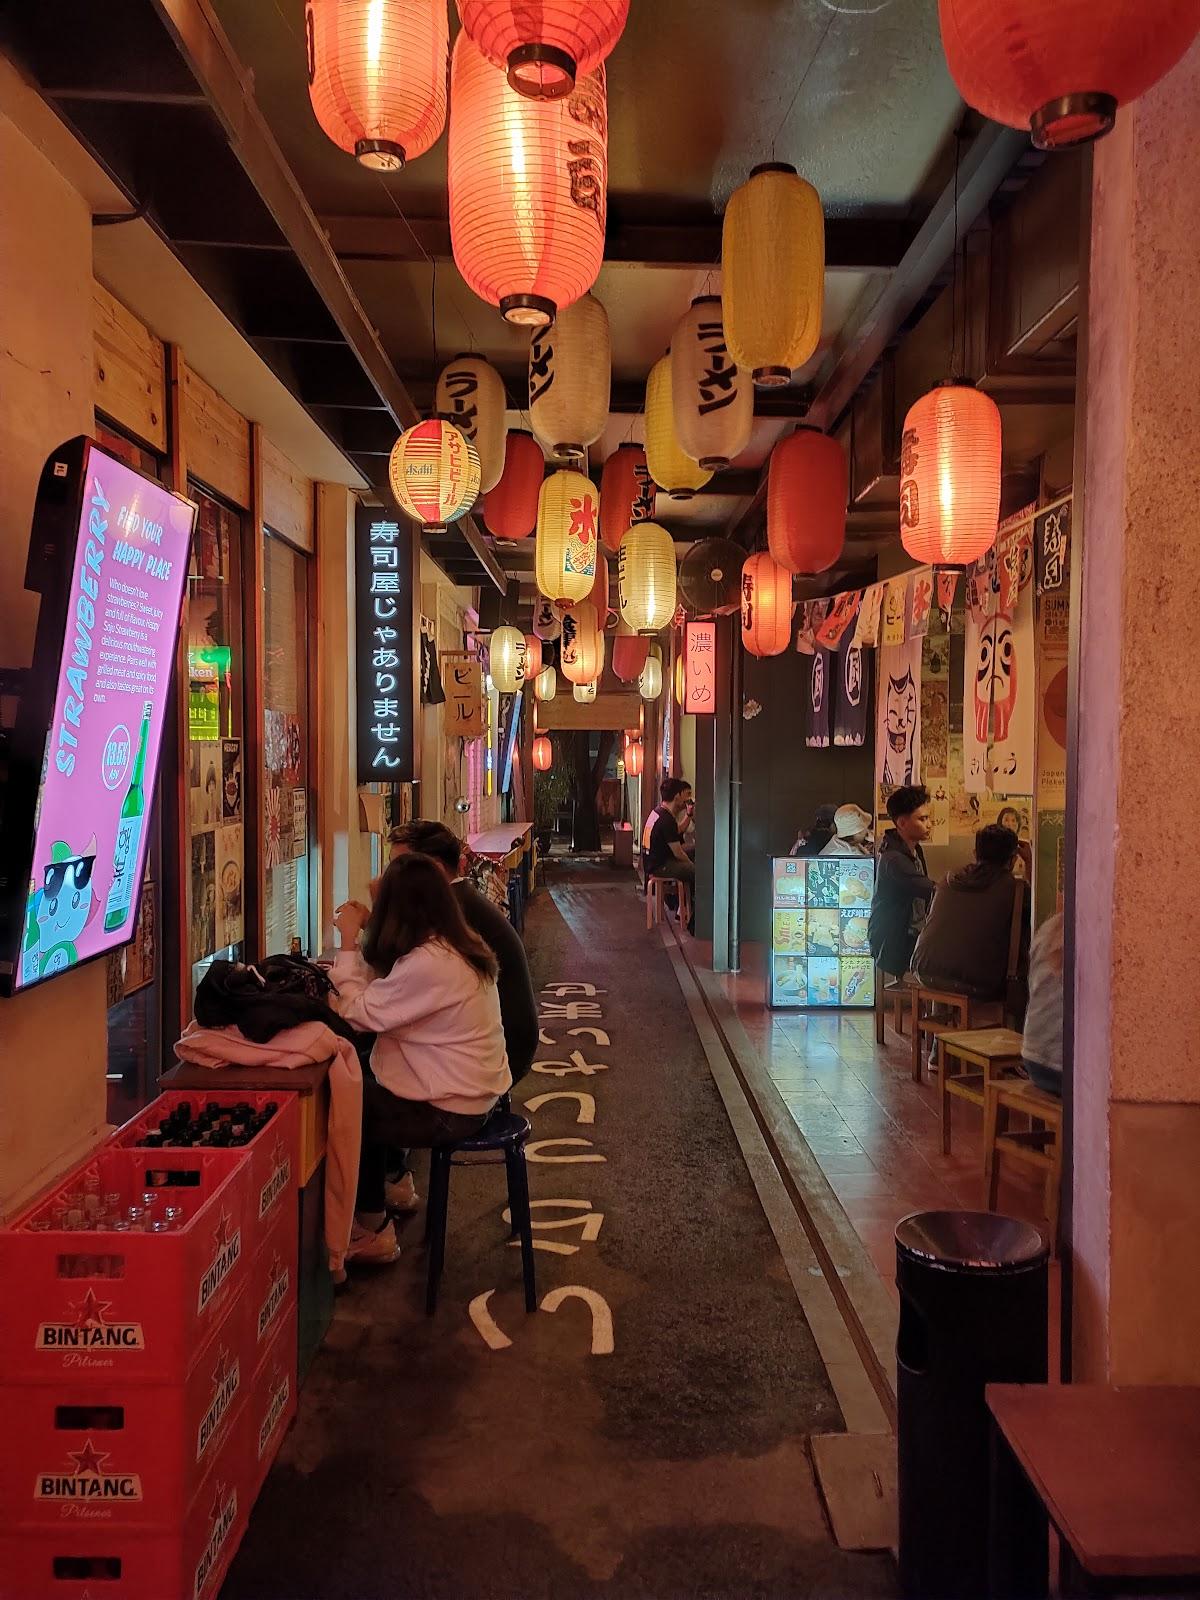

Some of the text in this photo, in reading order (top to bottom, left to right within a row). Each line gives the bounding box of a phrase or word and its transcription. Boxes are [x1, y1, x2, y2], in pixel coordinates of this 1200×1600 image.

[697, 322, 738, 416] ラーメン
[446, 371, 479, 441] ラーメ
[406, 463, 433, 475] Asahi
[142, 517, 163, 546] YOUR
[569, 494, 597, 545] 氷
[112, 540, 172, 581] HAPPY PLACE
[56, 477, 110, 777] STRAWBERRY
[370, 521, 400, 768] 寿司屋じゃありません
[453, 668, 474, 722] ビール
[690, 633, 713, 703] 濃いめ
[261, 1163, 289, 1207] BINTANG
[201, 1233, 240, 1307] BINTANG
[259, 1273, 288, 1333] BINTANG
[43, 1327, 139, 1346] BINTANG
[199, 1367, 239, 1449] BINTANG
[259, 1385, 288, 1449] BINTANG
[41, 1478, 138, 1497] BINTANG
[197, 1497, 237, 1589] BINTANG
